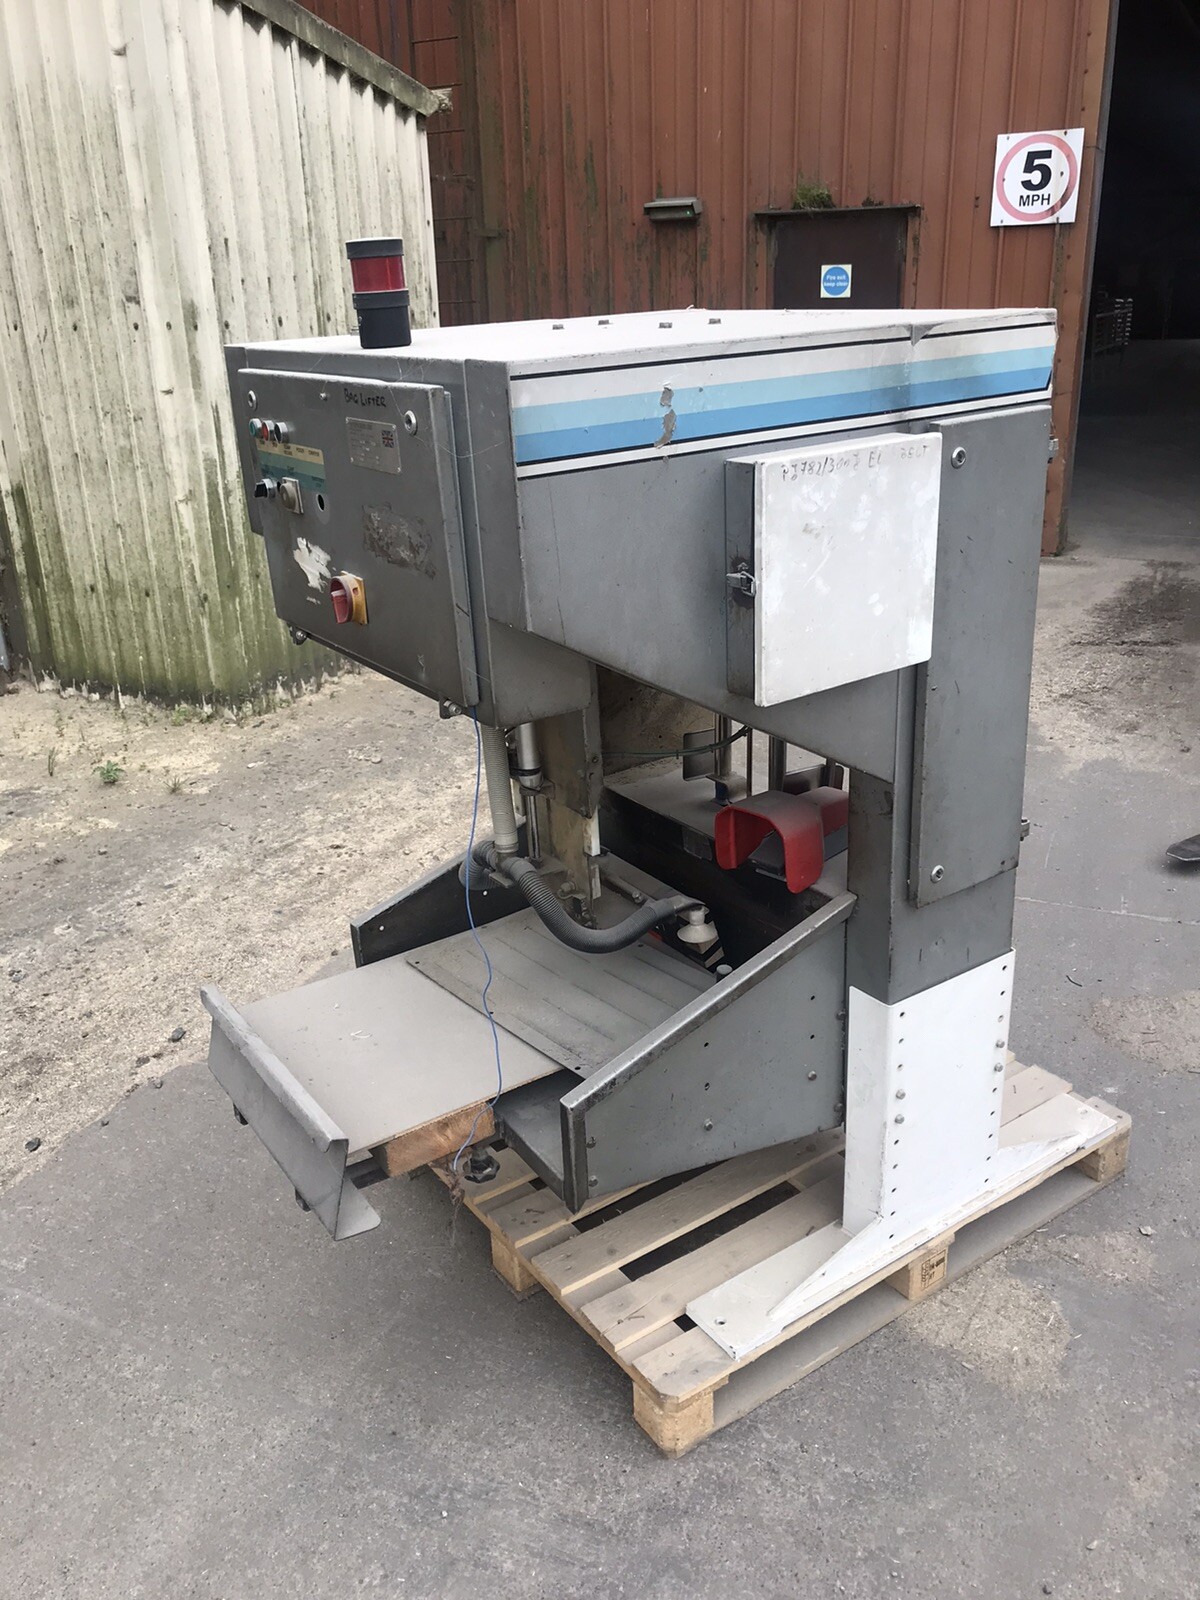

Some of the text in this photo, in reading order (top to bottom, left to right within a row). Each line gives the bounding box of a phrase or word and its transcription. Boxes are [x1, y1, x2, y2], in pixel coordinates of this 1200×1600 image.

[1020, 149, 1053, 192] 5
[1018, 193, 1051, 207] MPH
[344, 388, 387, 408] BAG LIFTER
